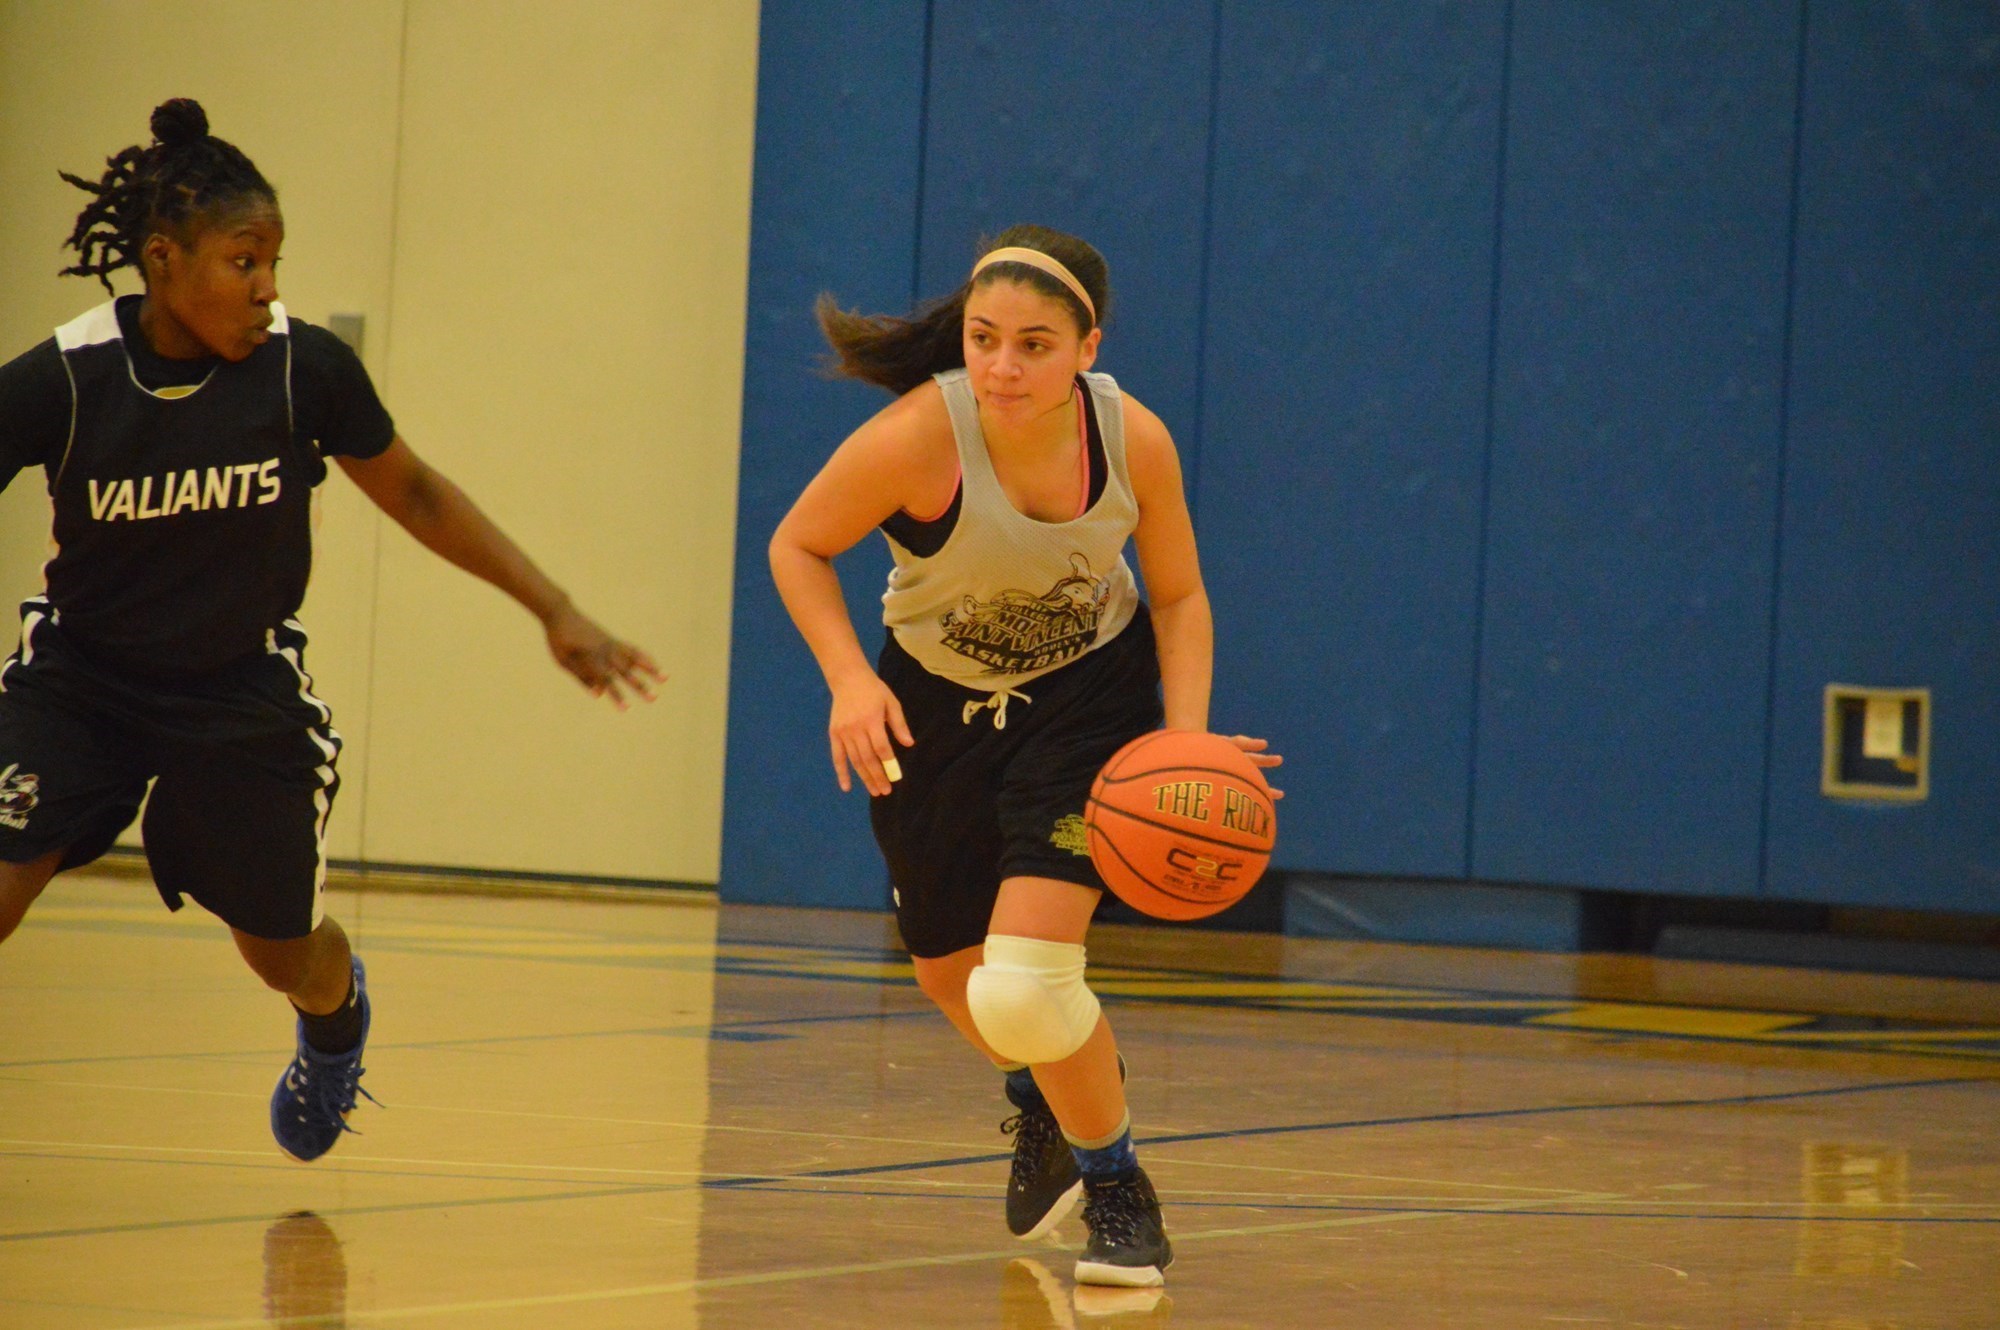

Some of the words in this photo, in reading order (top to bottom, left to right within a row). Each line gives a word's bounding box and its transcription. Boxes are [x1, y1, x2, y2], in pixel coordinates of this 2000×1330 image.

[88, 457, 281, 522] VALIANTS
[1152, 781, 1212, 823] THE
[1221, 786, 1271, 839] ROCK
